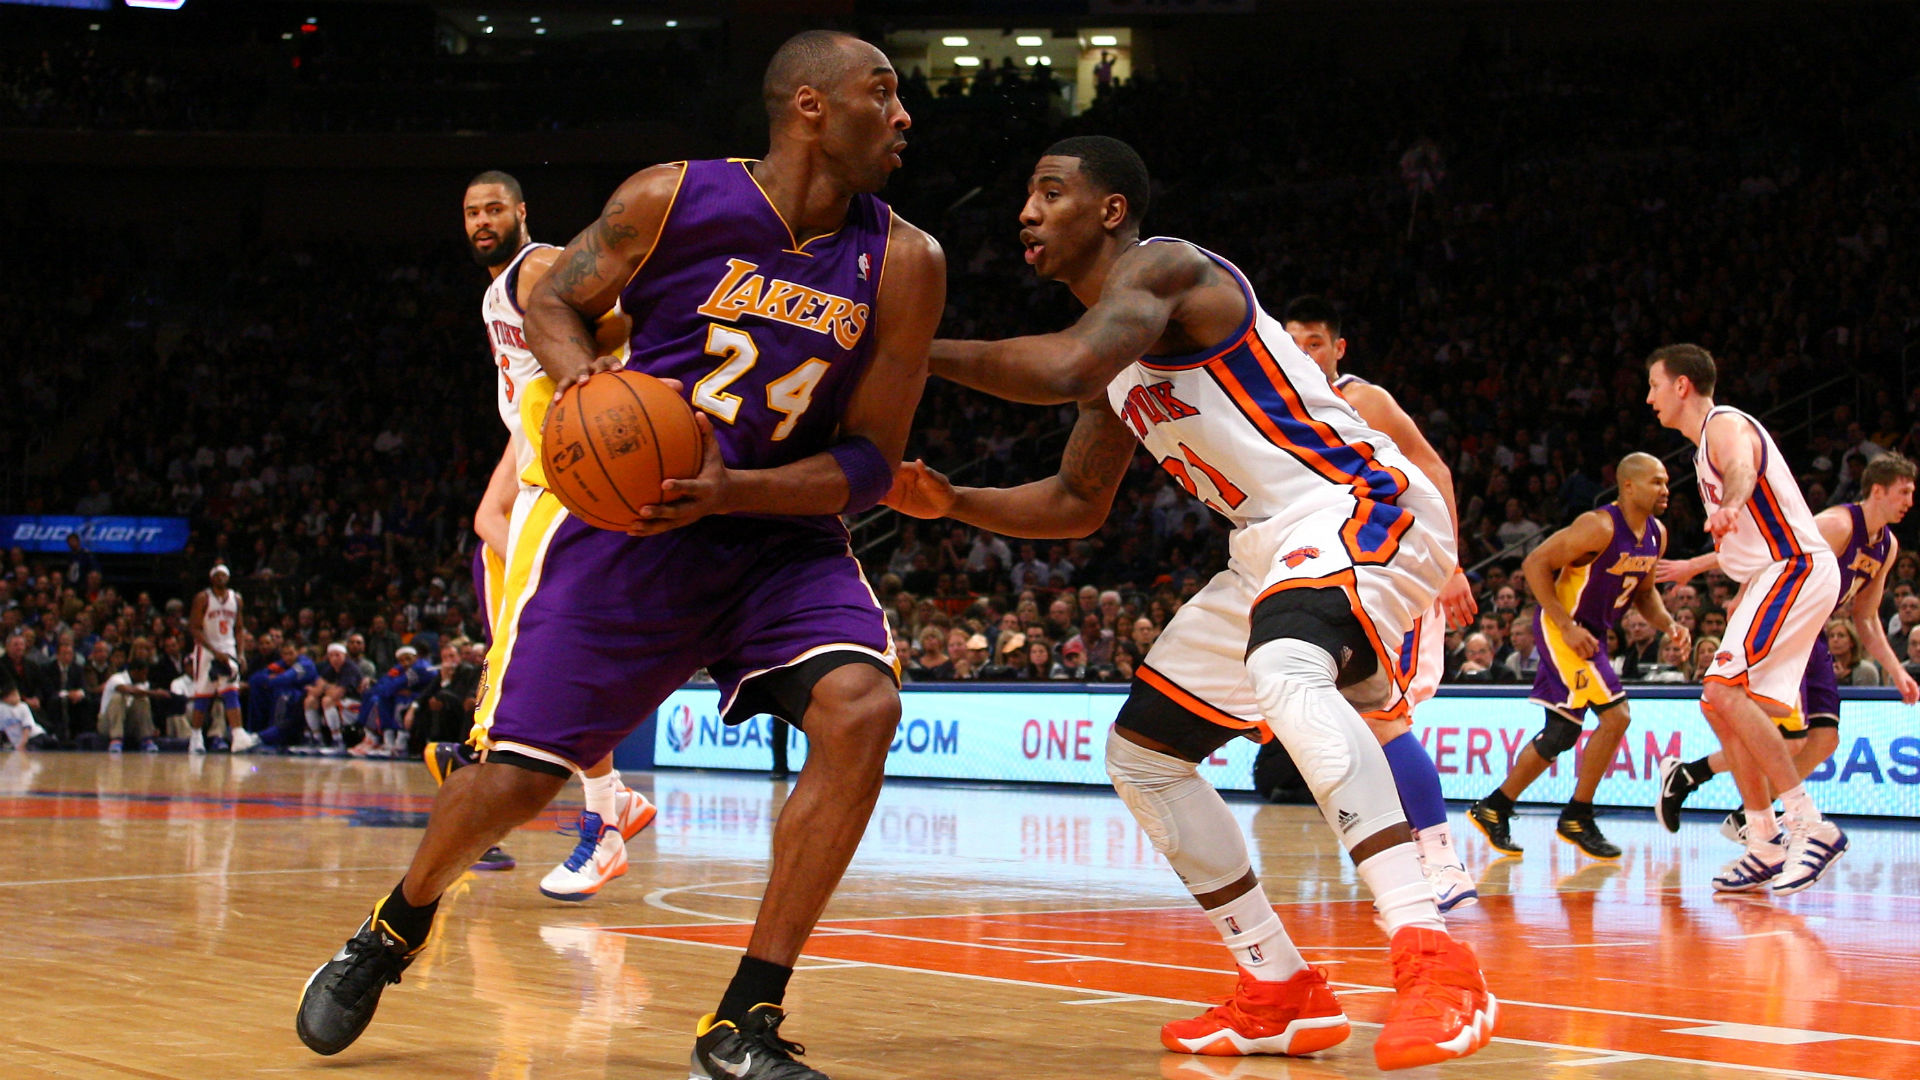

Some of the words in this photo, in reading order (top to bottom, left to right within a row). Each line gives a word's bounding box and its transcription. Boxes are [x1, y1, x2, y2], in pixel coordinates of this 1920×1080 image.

[697, 257, 870, 351] LAKERS
[692, 322, 831, 441] 24
[1613, 575, 1638, 608] 2
[1022, 719, 1093, 762] ONE
